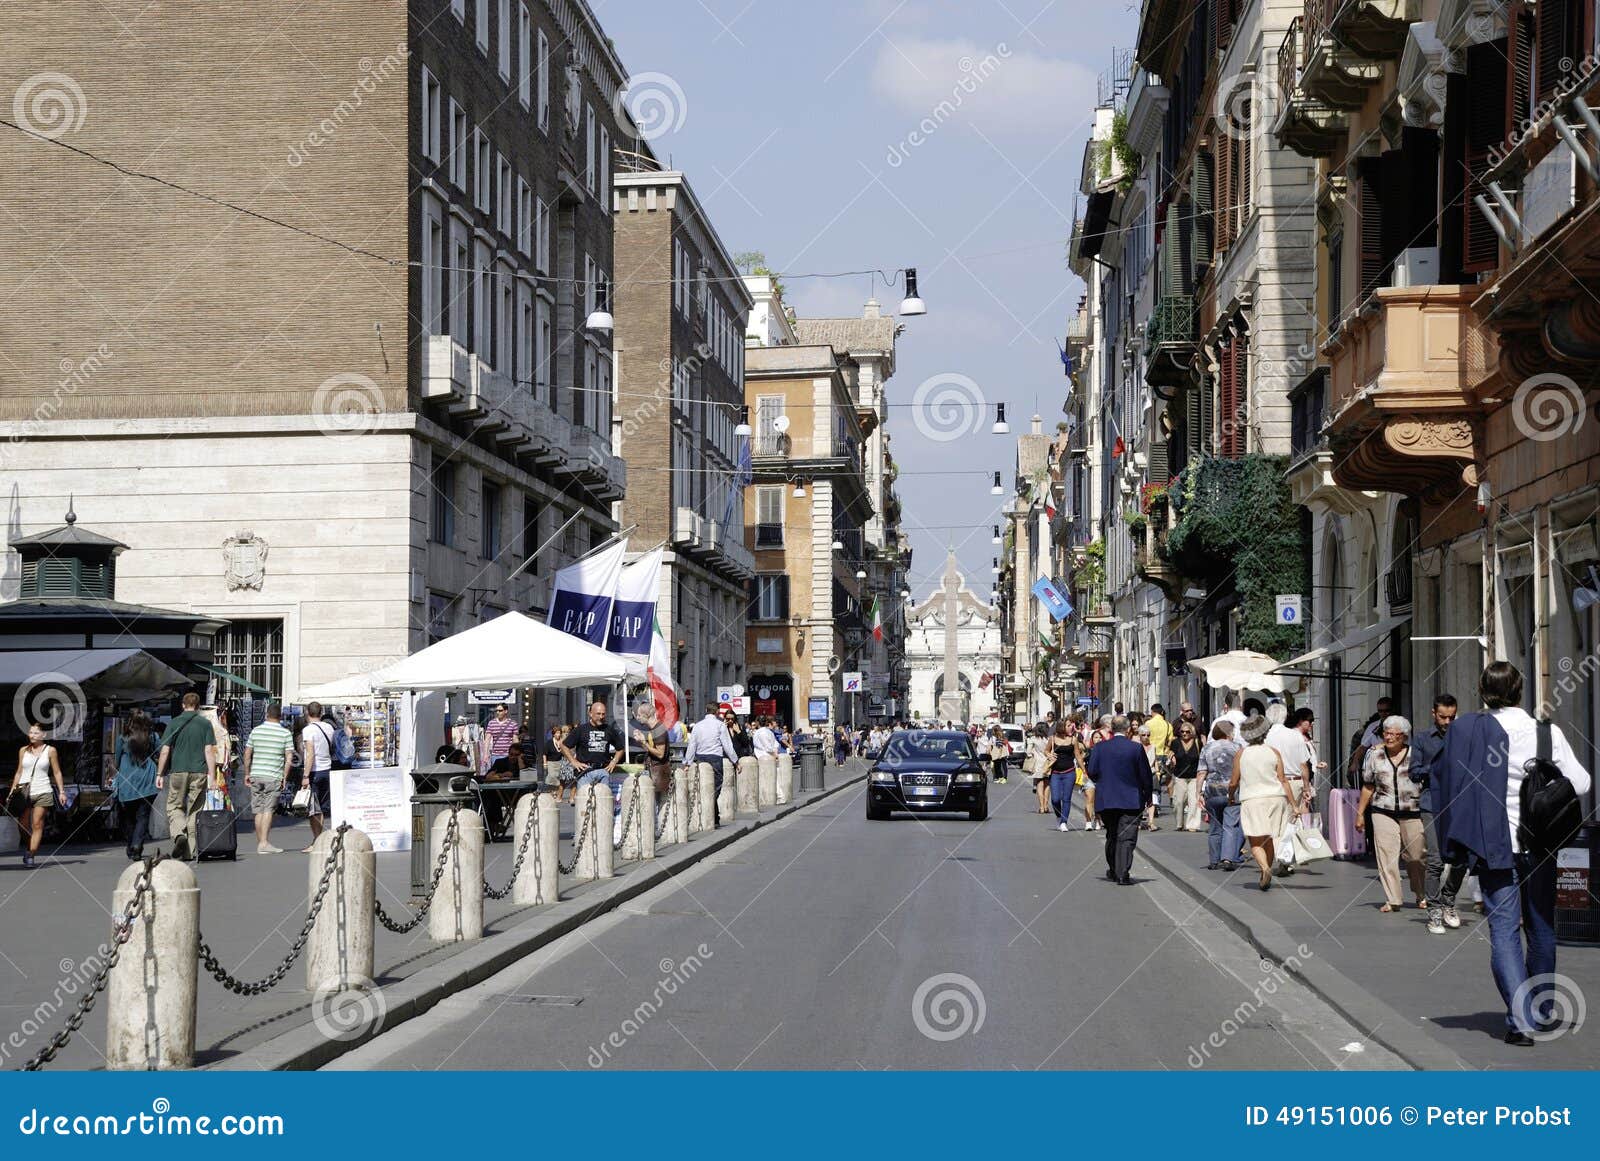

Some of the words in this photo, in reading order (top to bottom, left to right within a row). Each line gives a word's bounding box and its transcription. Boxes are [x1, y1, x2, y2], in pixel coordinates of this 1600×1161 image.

[563, 609, 596, 635] GAP
[612, 615, 642, 638] GAP
[750, 684, 790, 692] SEPHORA
